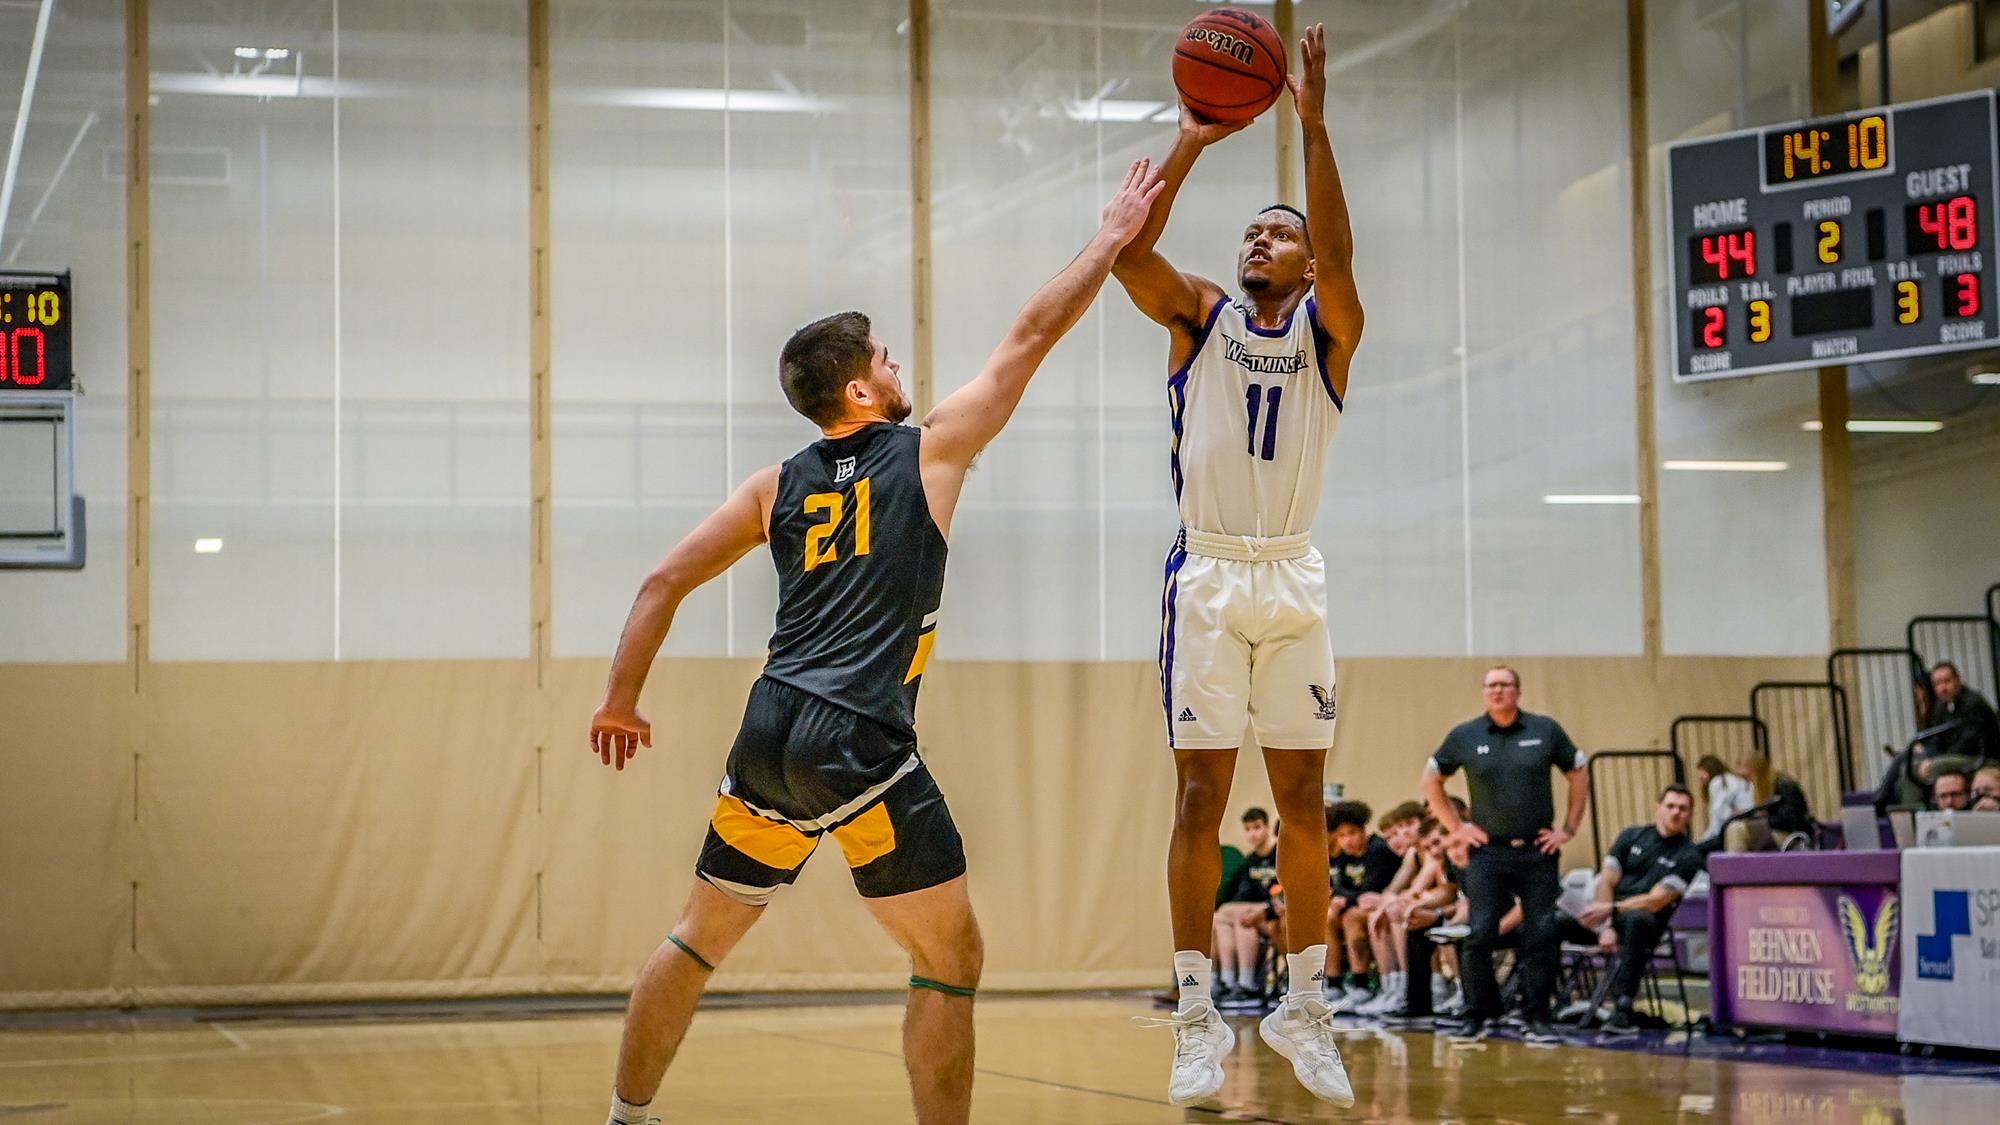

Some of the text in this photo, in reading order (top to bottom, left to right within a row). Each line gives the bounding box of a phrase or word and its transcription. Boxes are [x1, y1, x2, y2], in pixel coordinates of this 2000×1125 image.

[1186, 28, 1254, 65] Wilson
[1783, 116, 1886, 179] 14:10
[1906, 164, 1971, 198] GUEST
[1694, 199, 1748, 228] HOME
[1803, 196, 1851, 220] PERIOD
[1919, 196, 1976, 249] 48
[1702, 231, 1755, 279] 44
[1818, 220, 1840, 264] 2
[1787, 267, 1876, 296] PLAYER FOUL
[1938, 252, 1982, 275] FOULS
[0, 291, 59, 326] :10
[1688, 286, 1729, 308] FOULS
[1898, 281, 1919, 324] 3
[1957, 273, 1978, 317] 3
[1704, 306, 1725, 348] 2
[1750, 300, 1771, 343] 3
[1246, 383, 1282, 461] 11
[804, 477, 870, 572] 21
[1748, 927, 1823, 963] BEHNKEN
[1738, 965, 1835, 1004] FIELD HOUSE
